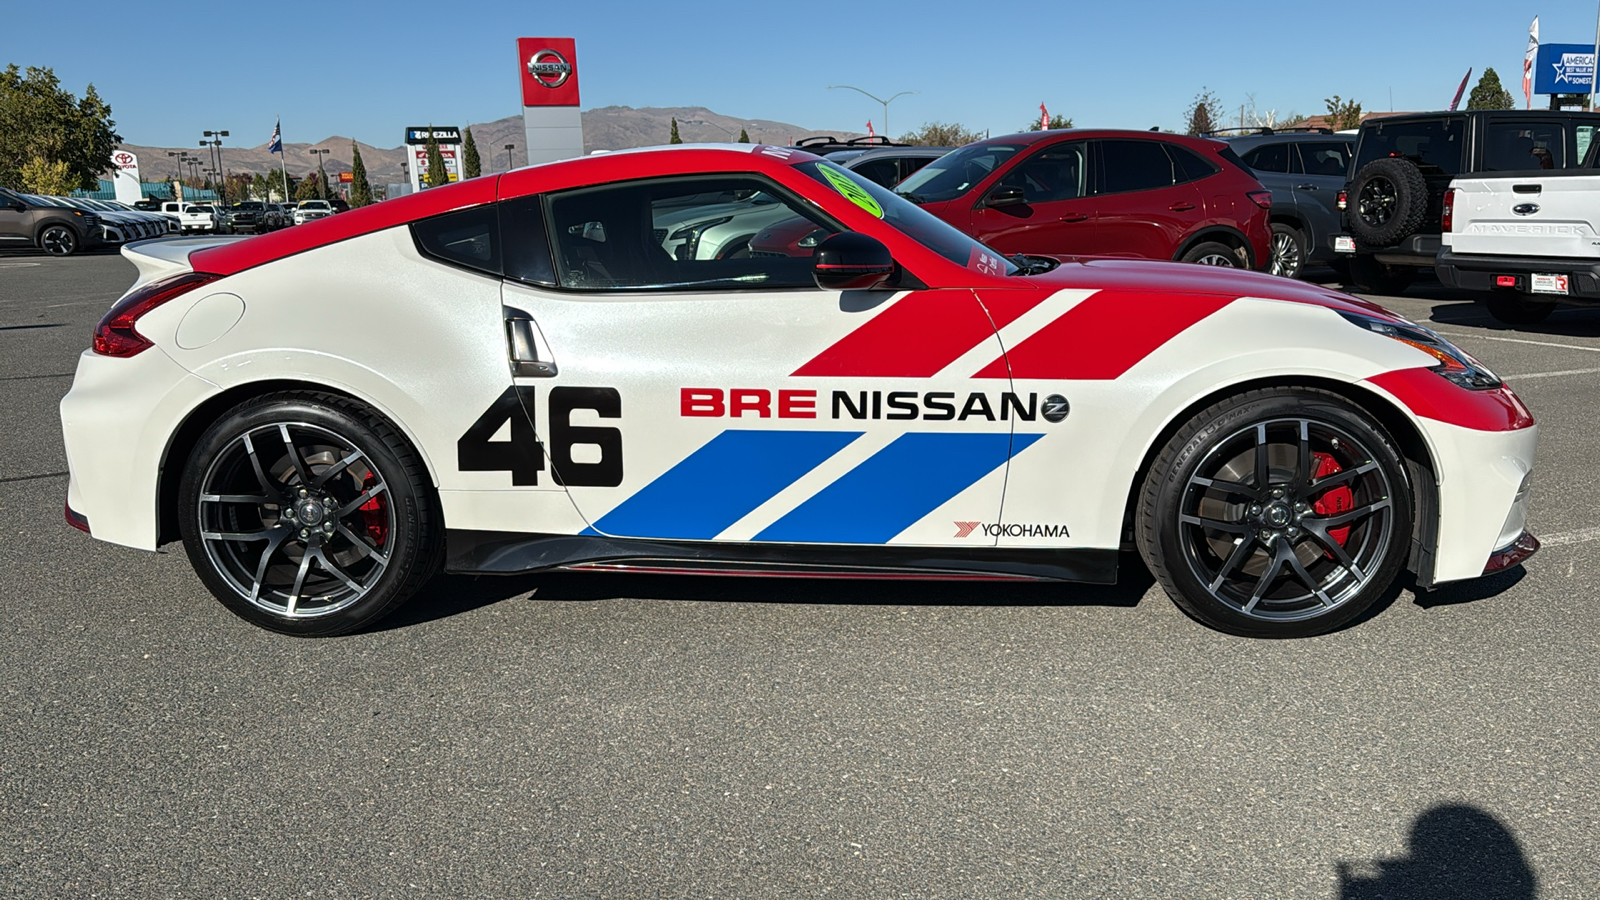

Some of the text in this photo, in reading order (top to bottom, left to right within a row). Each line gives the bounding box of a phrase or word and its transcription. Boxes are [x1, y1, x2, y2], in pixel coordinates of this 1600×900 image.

[1566, 56, 1594, 65] AMERICA
[1471, 225, 1586, 235] MAVERICK
[681, 388, 817, 418] BRE
[832, 391, 1037, 421] NISSAN
[458, 385, 623, 487] 46
[1168, 434, 1206, 483] GENERAL
[982, 524, 1070, 537] YOKOHAMA
